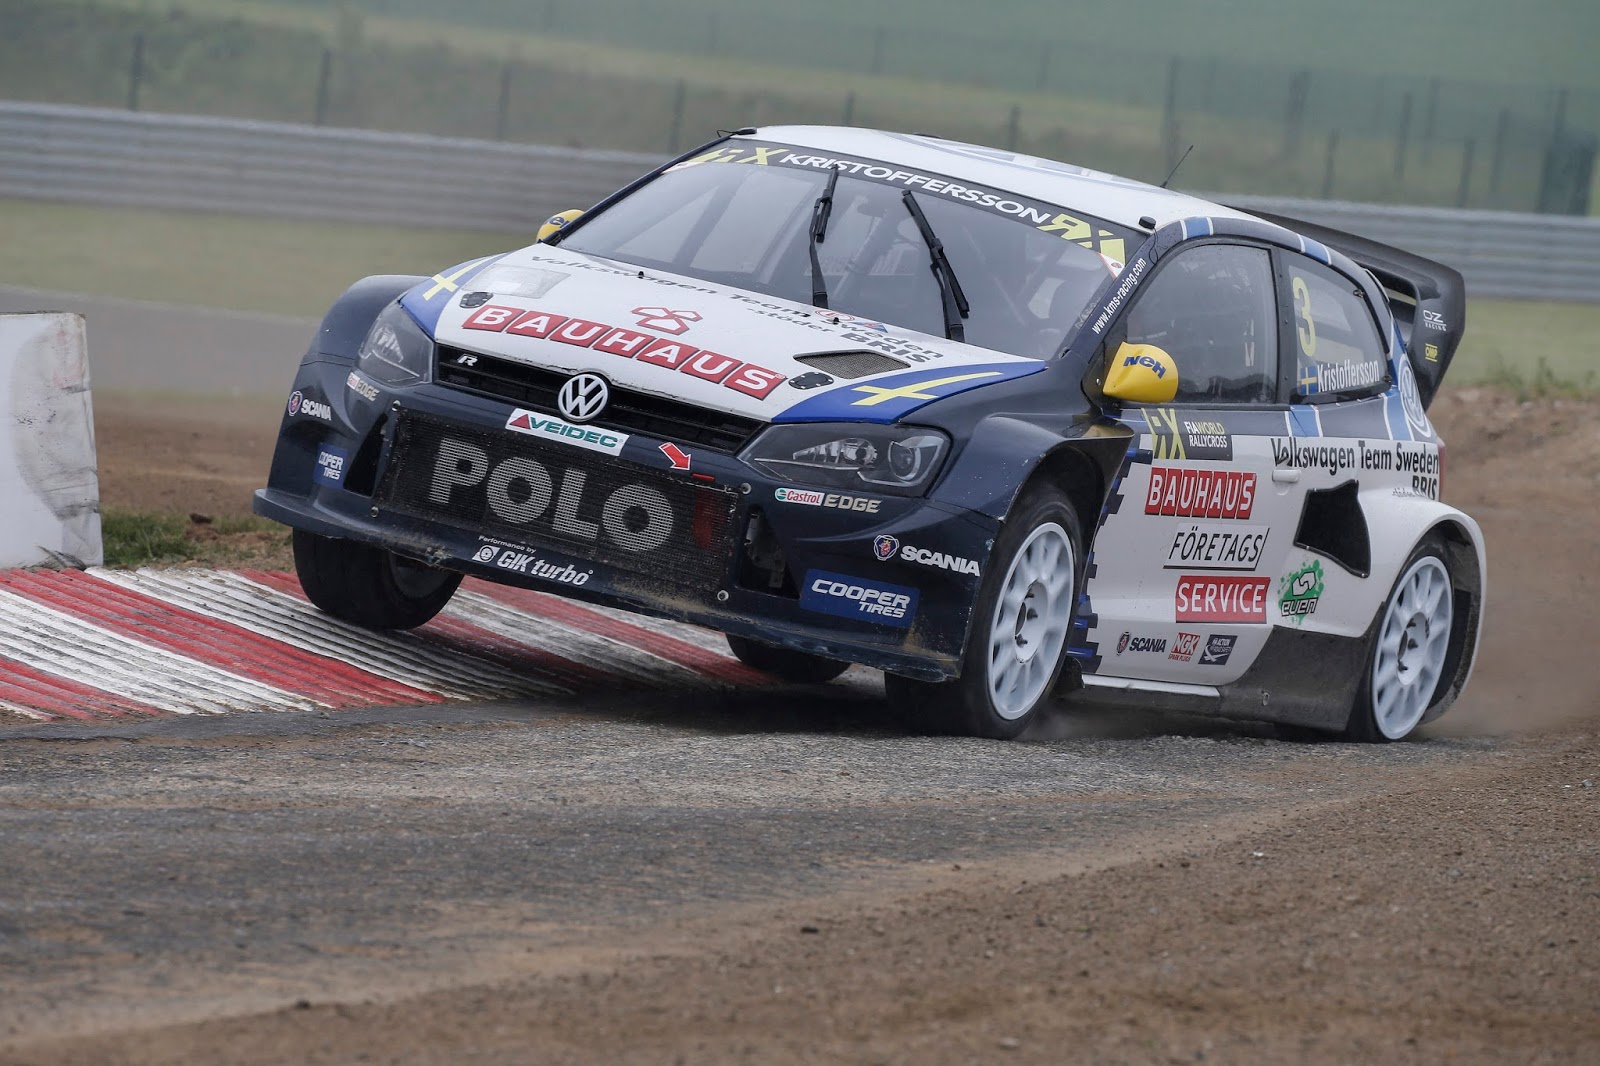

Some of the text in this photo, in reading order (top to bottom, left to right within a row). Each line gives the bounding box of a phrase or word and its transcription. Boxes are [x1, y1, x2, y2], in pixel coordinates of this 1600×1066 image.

[779, 153, 1051, 224] KRISTOFFERSSON
[532, 256, 944, 359] Volkswagen Team Sweden
[1091, 257, 1147, 335] www.kms-racing.com
[1292, 277, 1317, 357] 3
[457, 355, 478, 367] R
[474, 307, 782, 393] BAUHAUS
[840, 332, 932, 363] BRIS
[356, 379, 380, 402] EDGE
[1317, 359, 1380, 393] Kristoffersson
[301, 398, 332, 422] SCANIA
[529, 416, 620, 448] VEIDEC
[1189, 434, 1228, 448] RALLYCROSS
[318, 451, 344, 470] COOPER
[1271, 437, 1439, 476] Volkswagen Team Sweden
[324, 467, 341, 481] TIRES
[428, 436, 674, 552] POLO
[786, 488, 882, 514] Castrol EDGE
[1148, 474, 1254, 512] BAUHAUS
[478, 535, 537, 554] Performance by
[1168, 526, 1264, 563] FÖRETAGS
[530, 558, 590, 586] turbo
[900, 545, 981, 577] SCANIA
[811, 578, 911, 609] COOPER
[1176, 583, 1267, 615] SERVICE
[858, 601, 907, 619] TIRES
[1129, 636, 1167, 653] SCANIA
[1172, 633, 1200, 655] NGK
